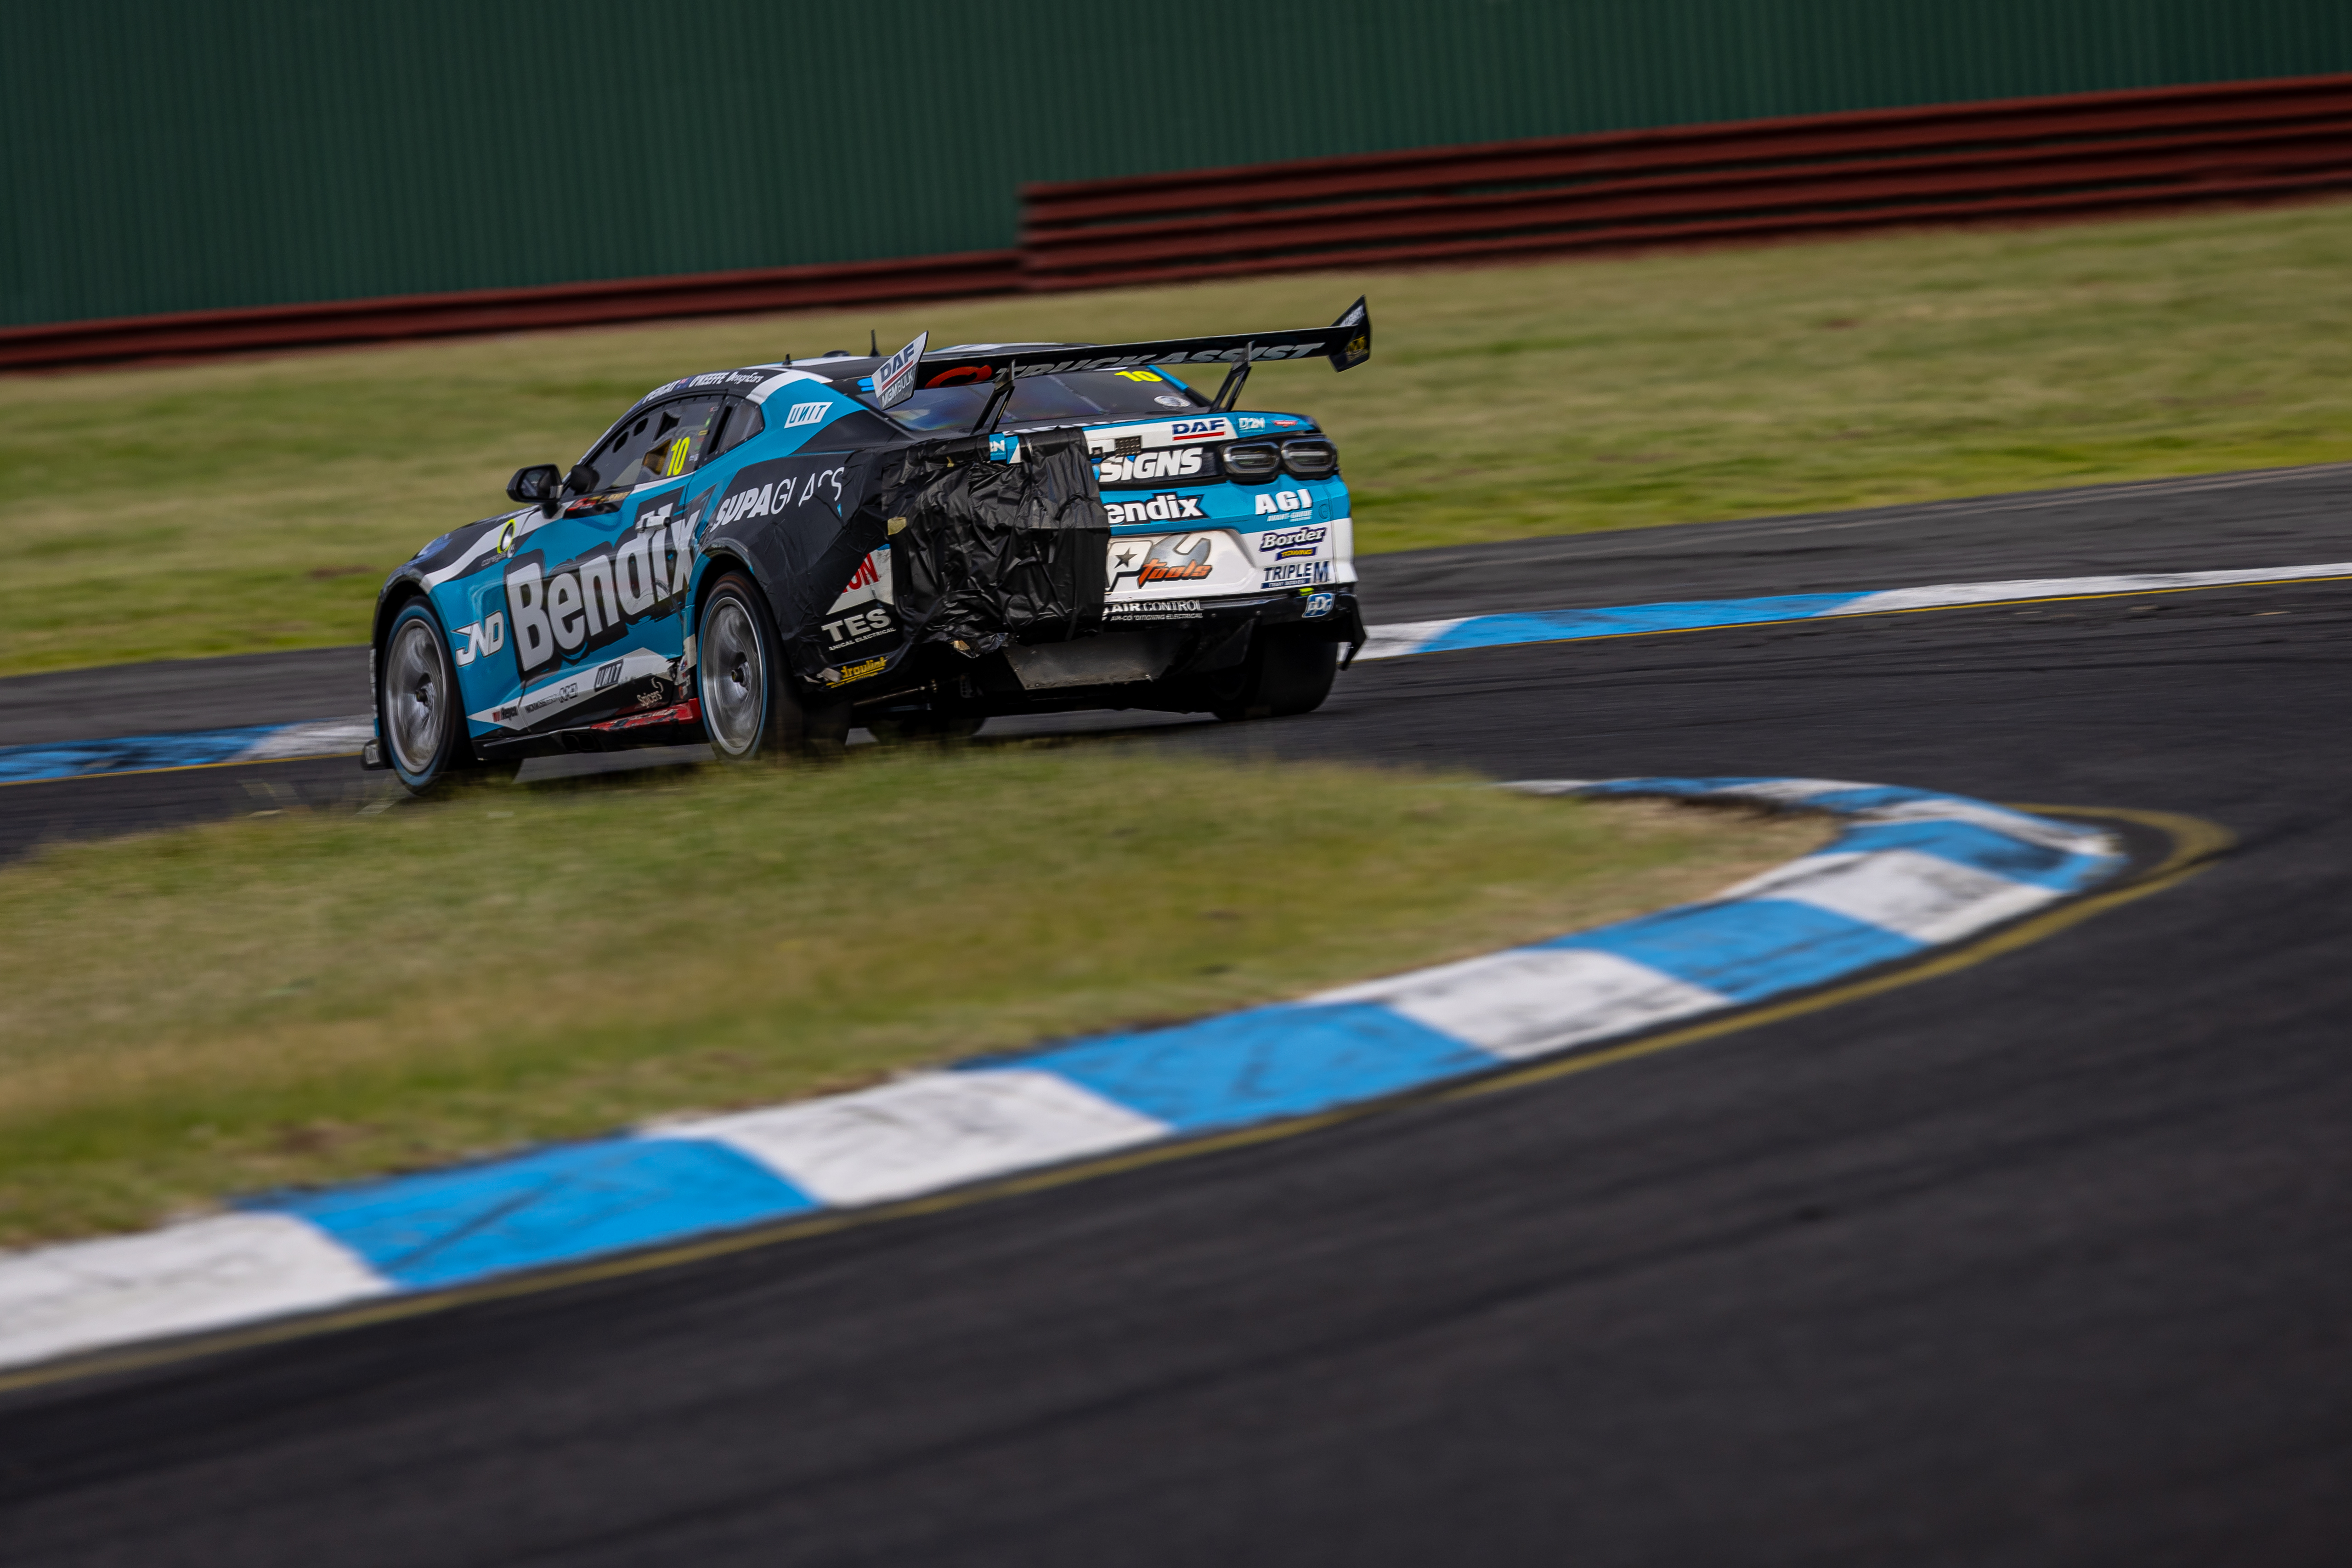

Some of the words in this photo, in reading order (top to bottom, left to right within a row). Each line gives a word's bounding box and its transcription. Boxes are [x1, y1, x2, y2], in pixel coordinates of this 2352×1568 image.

[880, 343, 914, 383] DAF
[995, 354, 1157, 379] TRUCK
[1150, 342, 1326, 364] ASSIST
[1114, 371, 1163, 382] 10
[788, 404, 827, 424] UNIT
[1172, 419, 1225, 435] DAF
[666, 436, 690, 476] 10
[1099, 447, 1204, 482] SIGNS
[1103, 494, 1204, 524] endix
[1255, 489, 1312, 515] AGI
[1261, 528, 1326, 549] Border
[1137, 558, 1213, 589] tools
[1264, 562, 1312, 581] TRIPLE
[1314, 560, 1329, 583] M
[506, 502, 701, 672] Bendix
[1112, 603, 1141, 612] AIR
[1142, 600, 1204, 612] CONTROL
[1309, 596, 1333, 616] PPG
[855, 627, 897, 643] ELECTRICAL
[637, 691, 662, 708] Spicers
